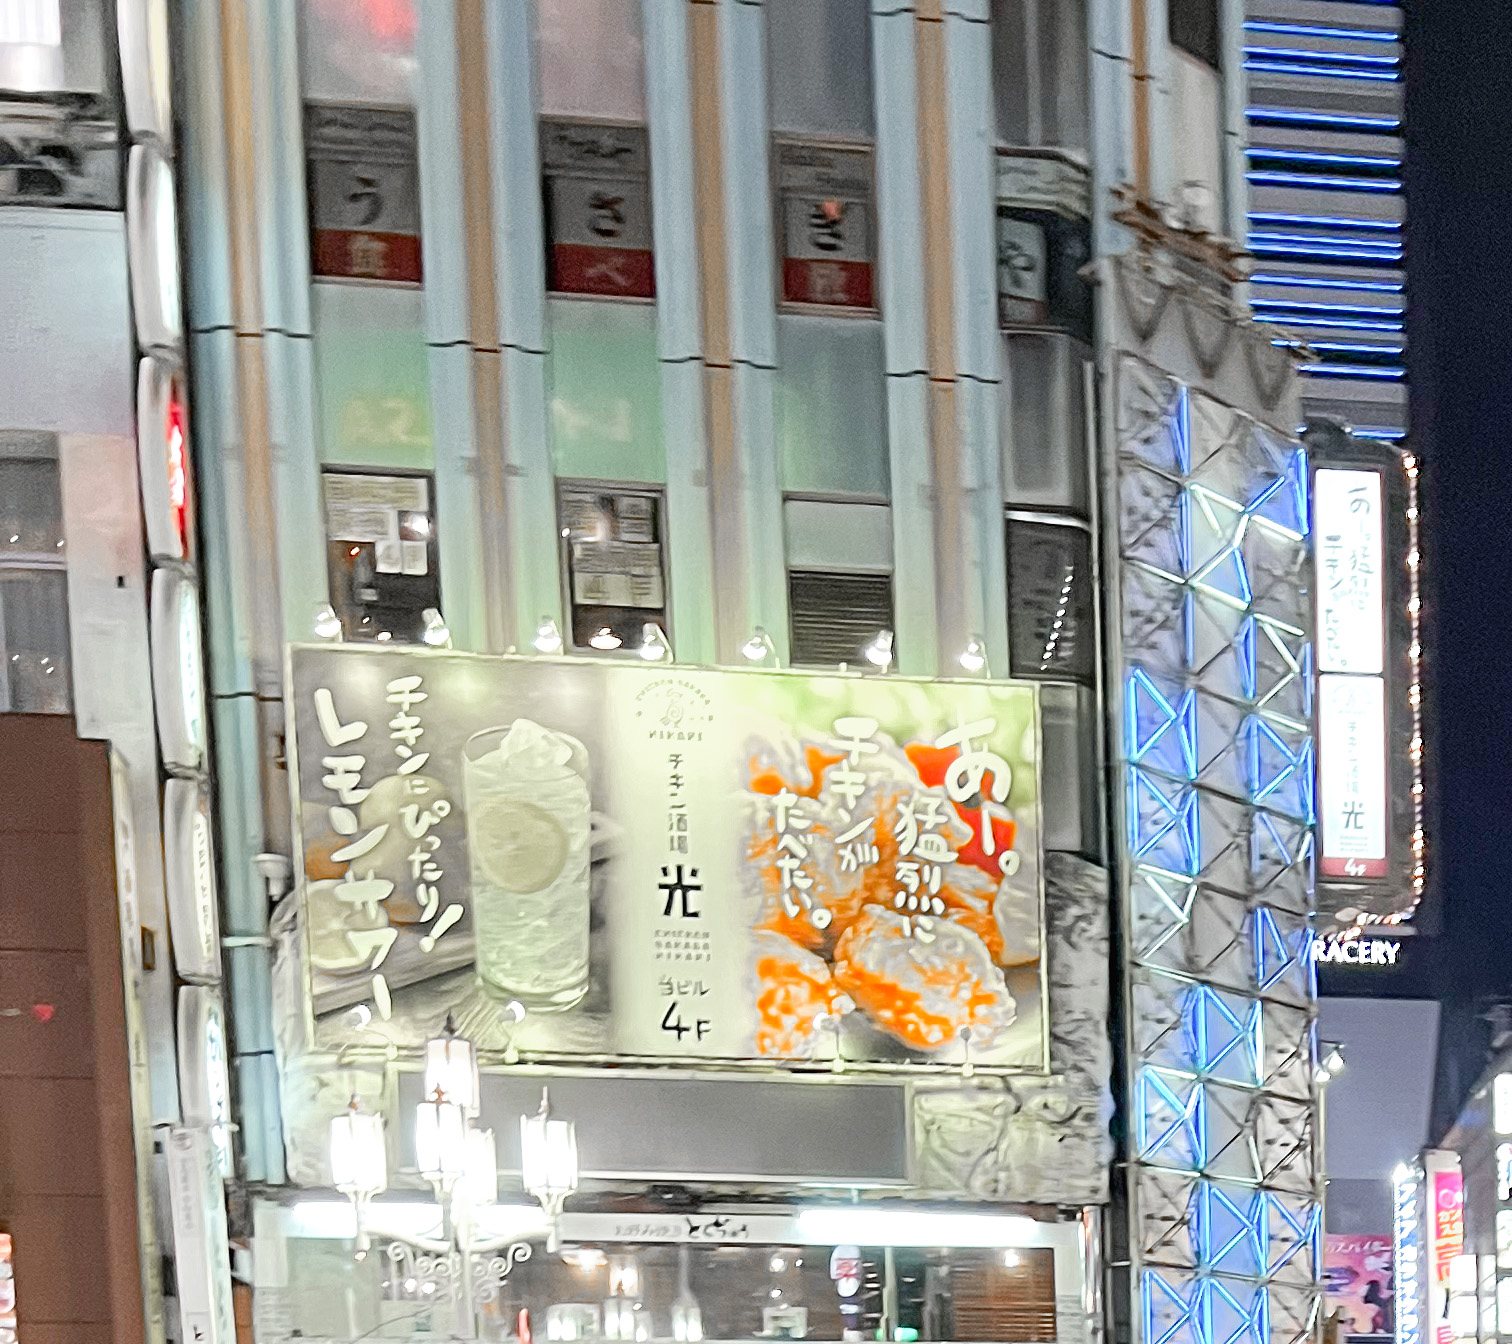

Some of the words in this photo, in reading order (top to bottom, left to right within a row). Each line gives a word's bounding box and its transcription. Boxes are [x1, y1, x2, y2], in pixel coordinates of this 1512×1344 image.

[314, 688, 399, 1021] レモンサワー
[776, 786, 832, 930] たべたい。
[829, 716, 880, 872] チキンが
[935, 717, 1020, 876] あー。
[1341, 800, 1365, 830] 光
[657, 864, 704, 918] 光
[1311, 938, 1401, 965] RACERY
